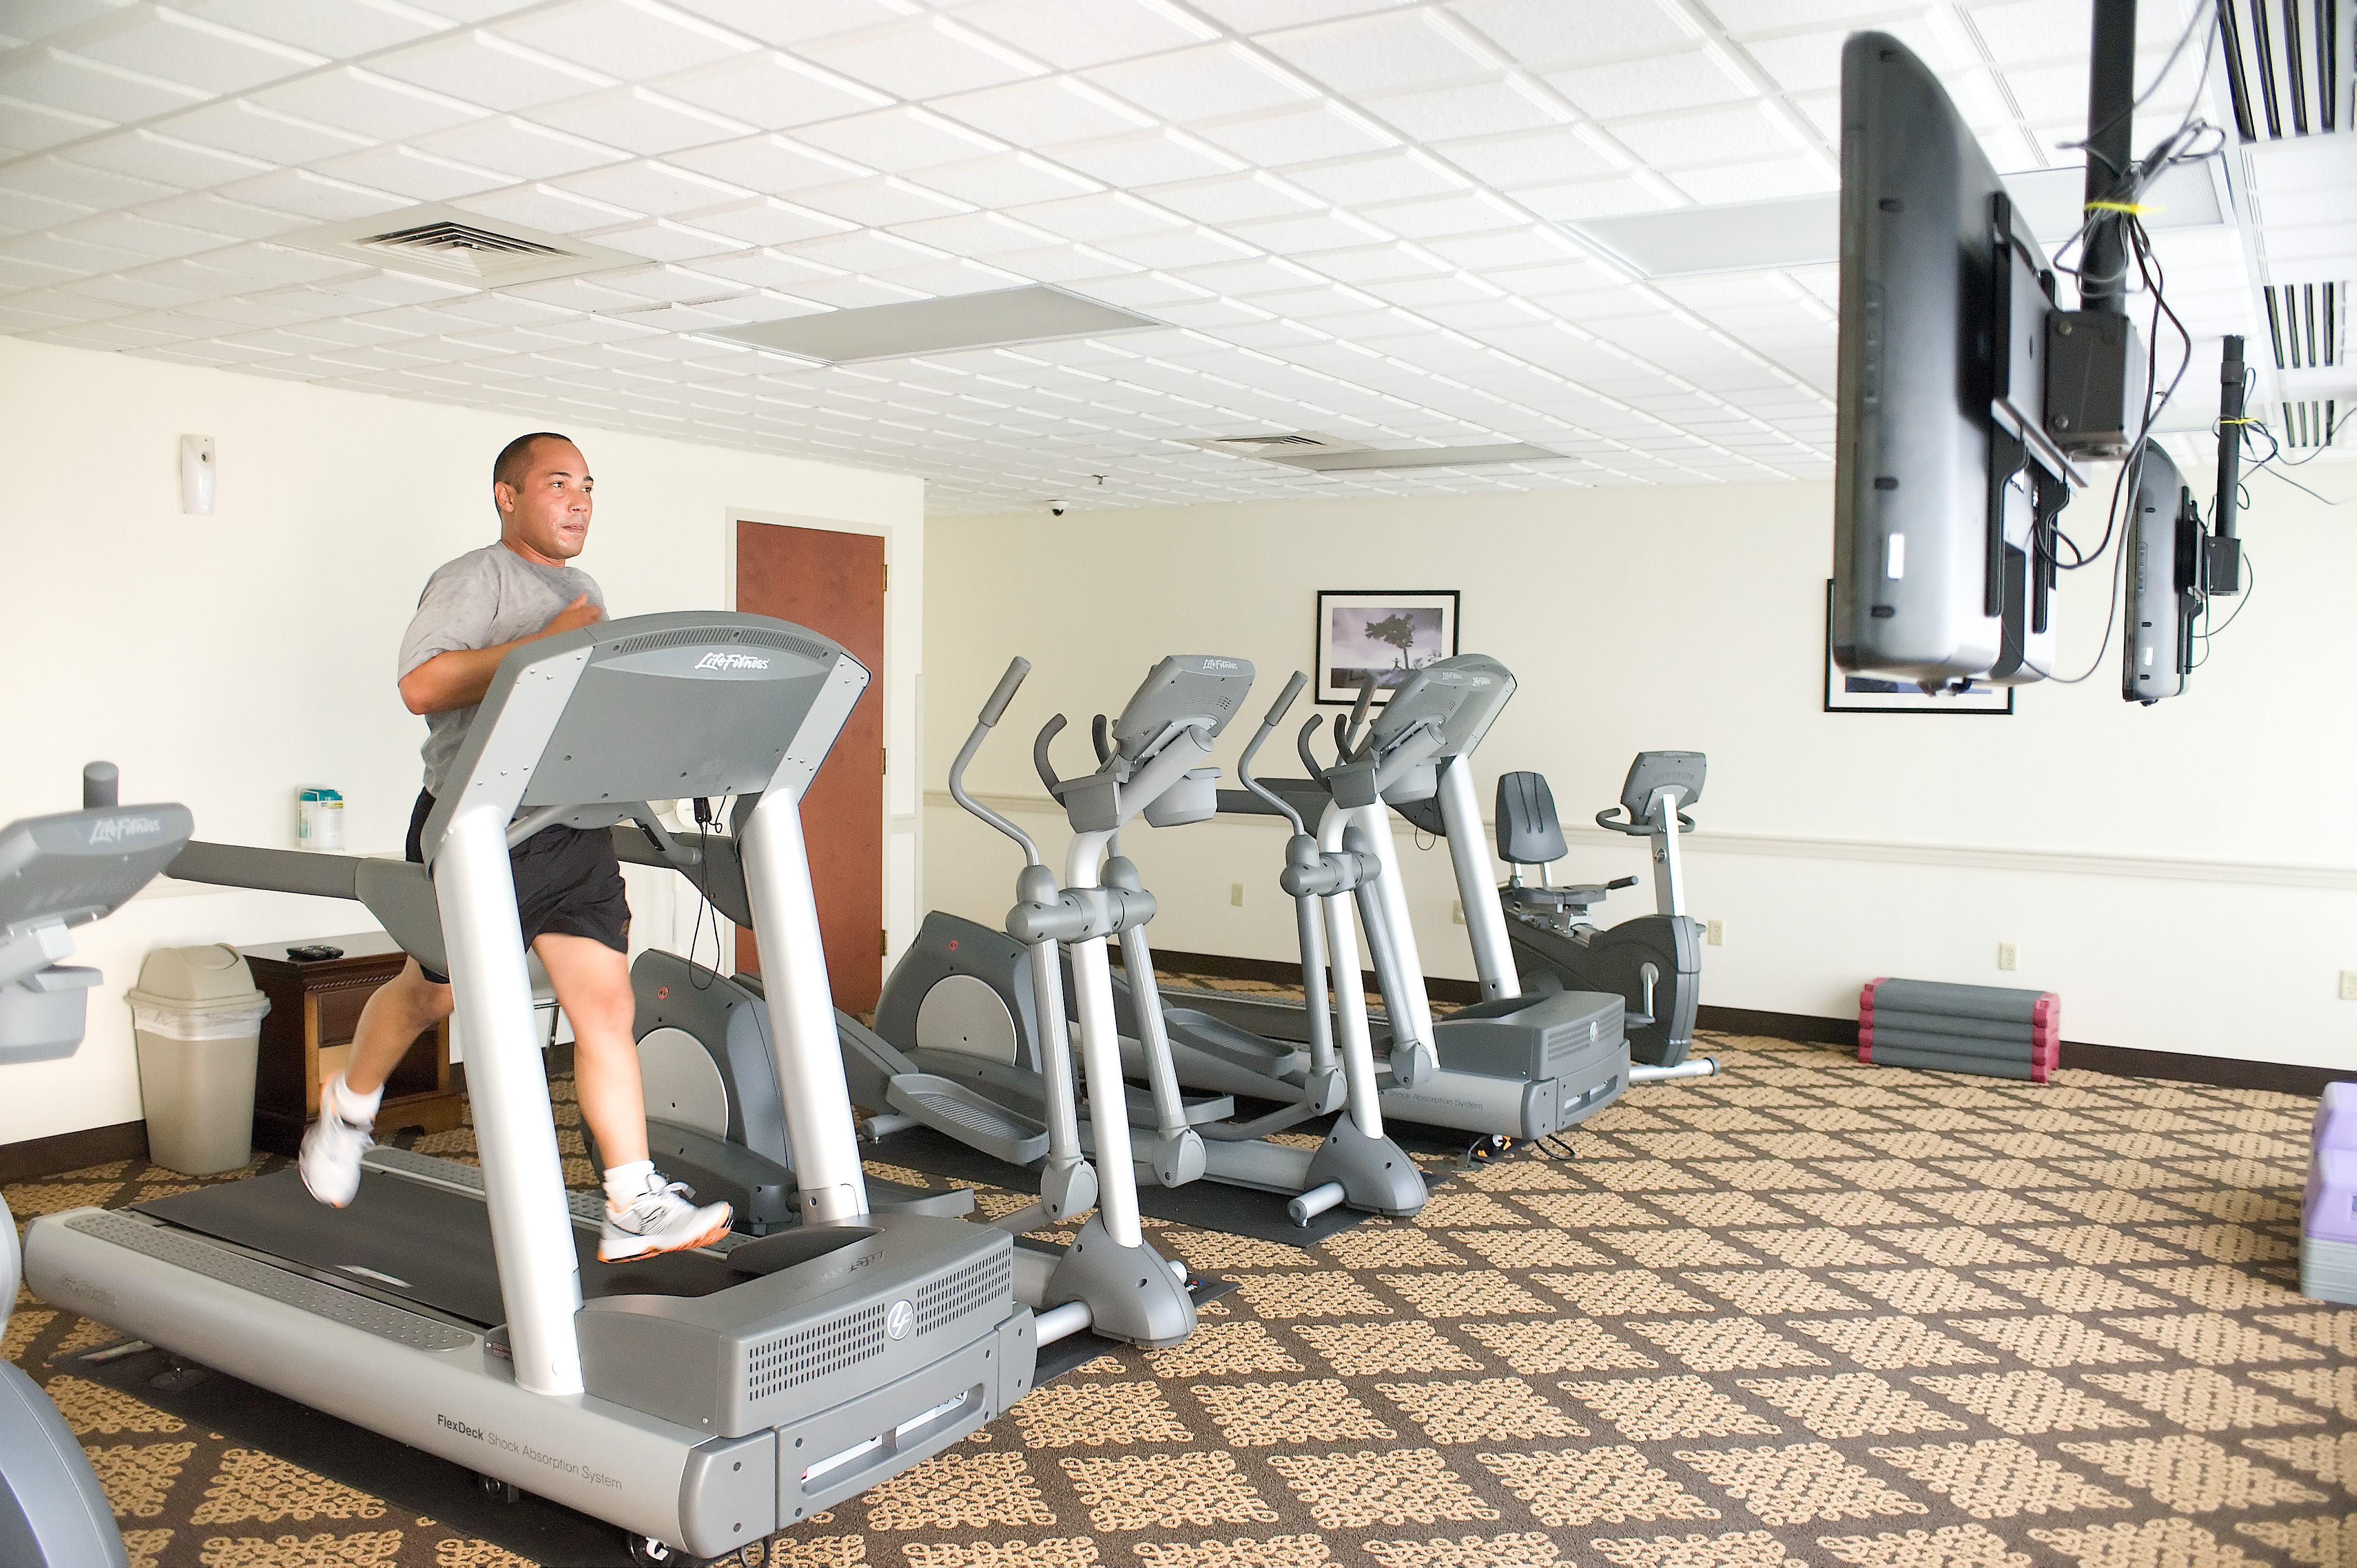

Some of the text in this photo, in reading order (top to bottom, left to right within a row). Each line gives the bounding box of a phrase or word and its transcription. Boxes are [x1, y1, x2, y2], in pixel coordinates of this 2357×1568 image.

[438, 1414, 622, 1490] FlexDeck Shock Absorption System
